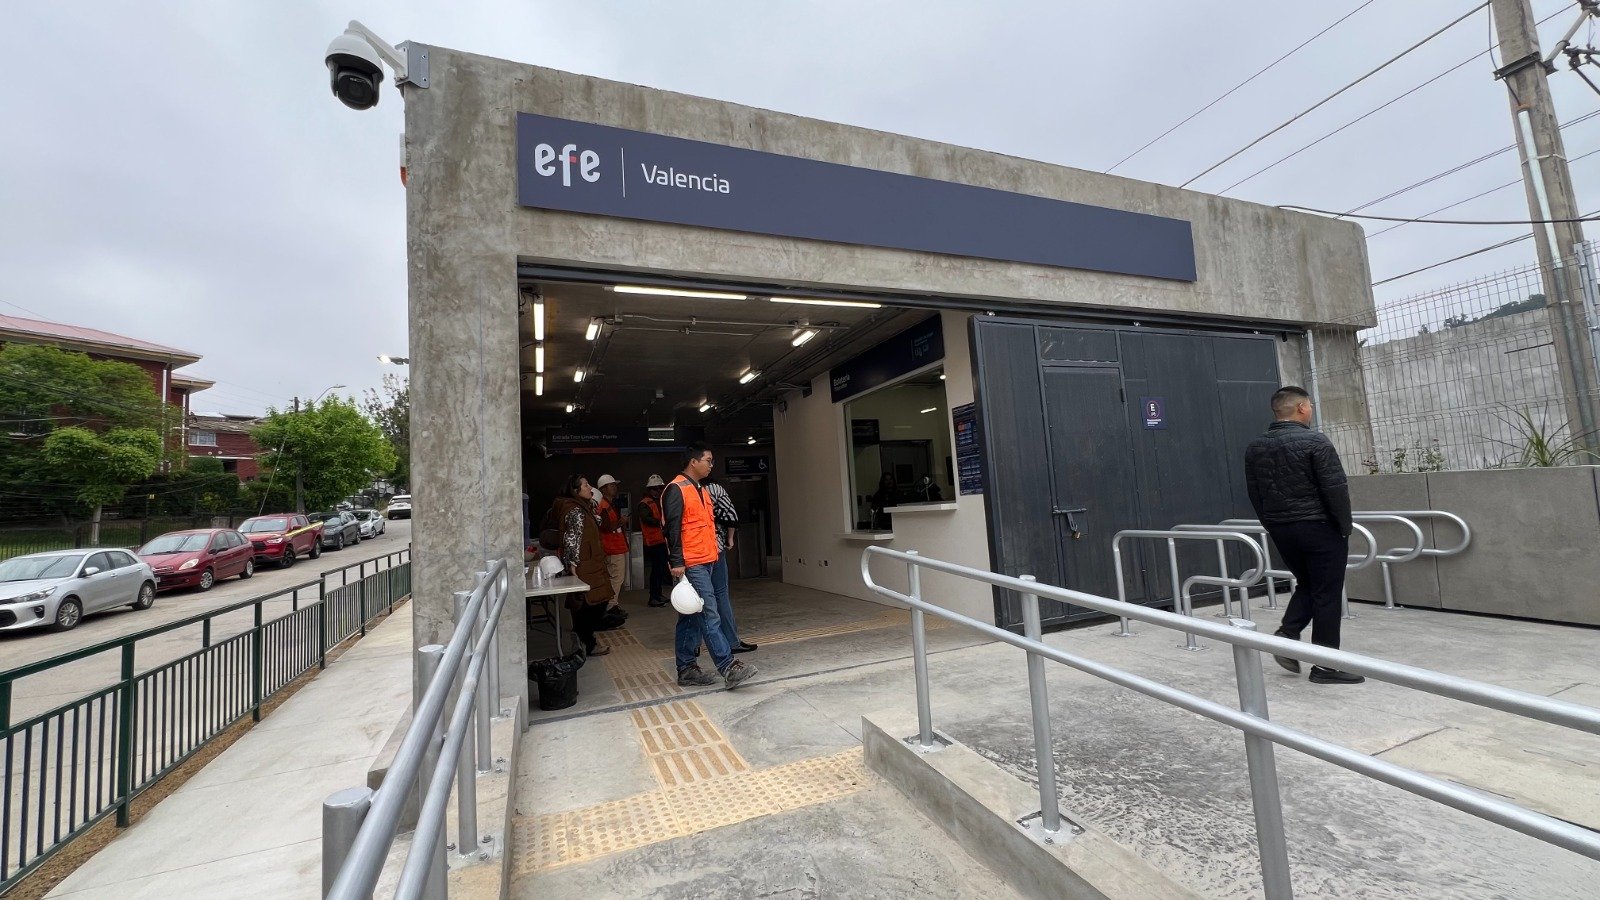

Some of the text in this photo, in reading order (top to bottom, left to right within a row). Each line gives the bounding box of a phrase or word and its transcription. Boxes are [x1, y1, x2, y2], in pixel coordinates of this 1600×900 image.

[534, 143, 730, 194] efe Valencia
[1150, 403, 1155, 411] E
